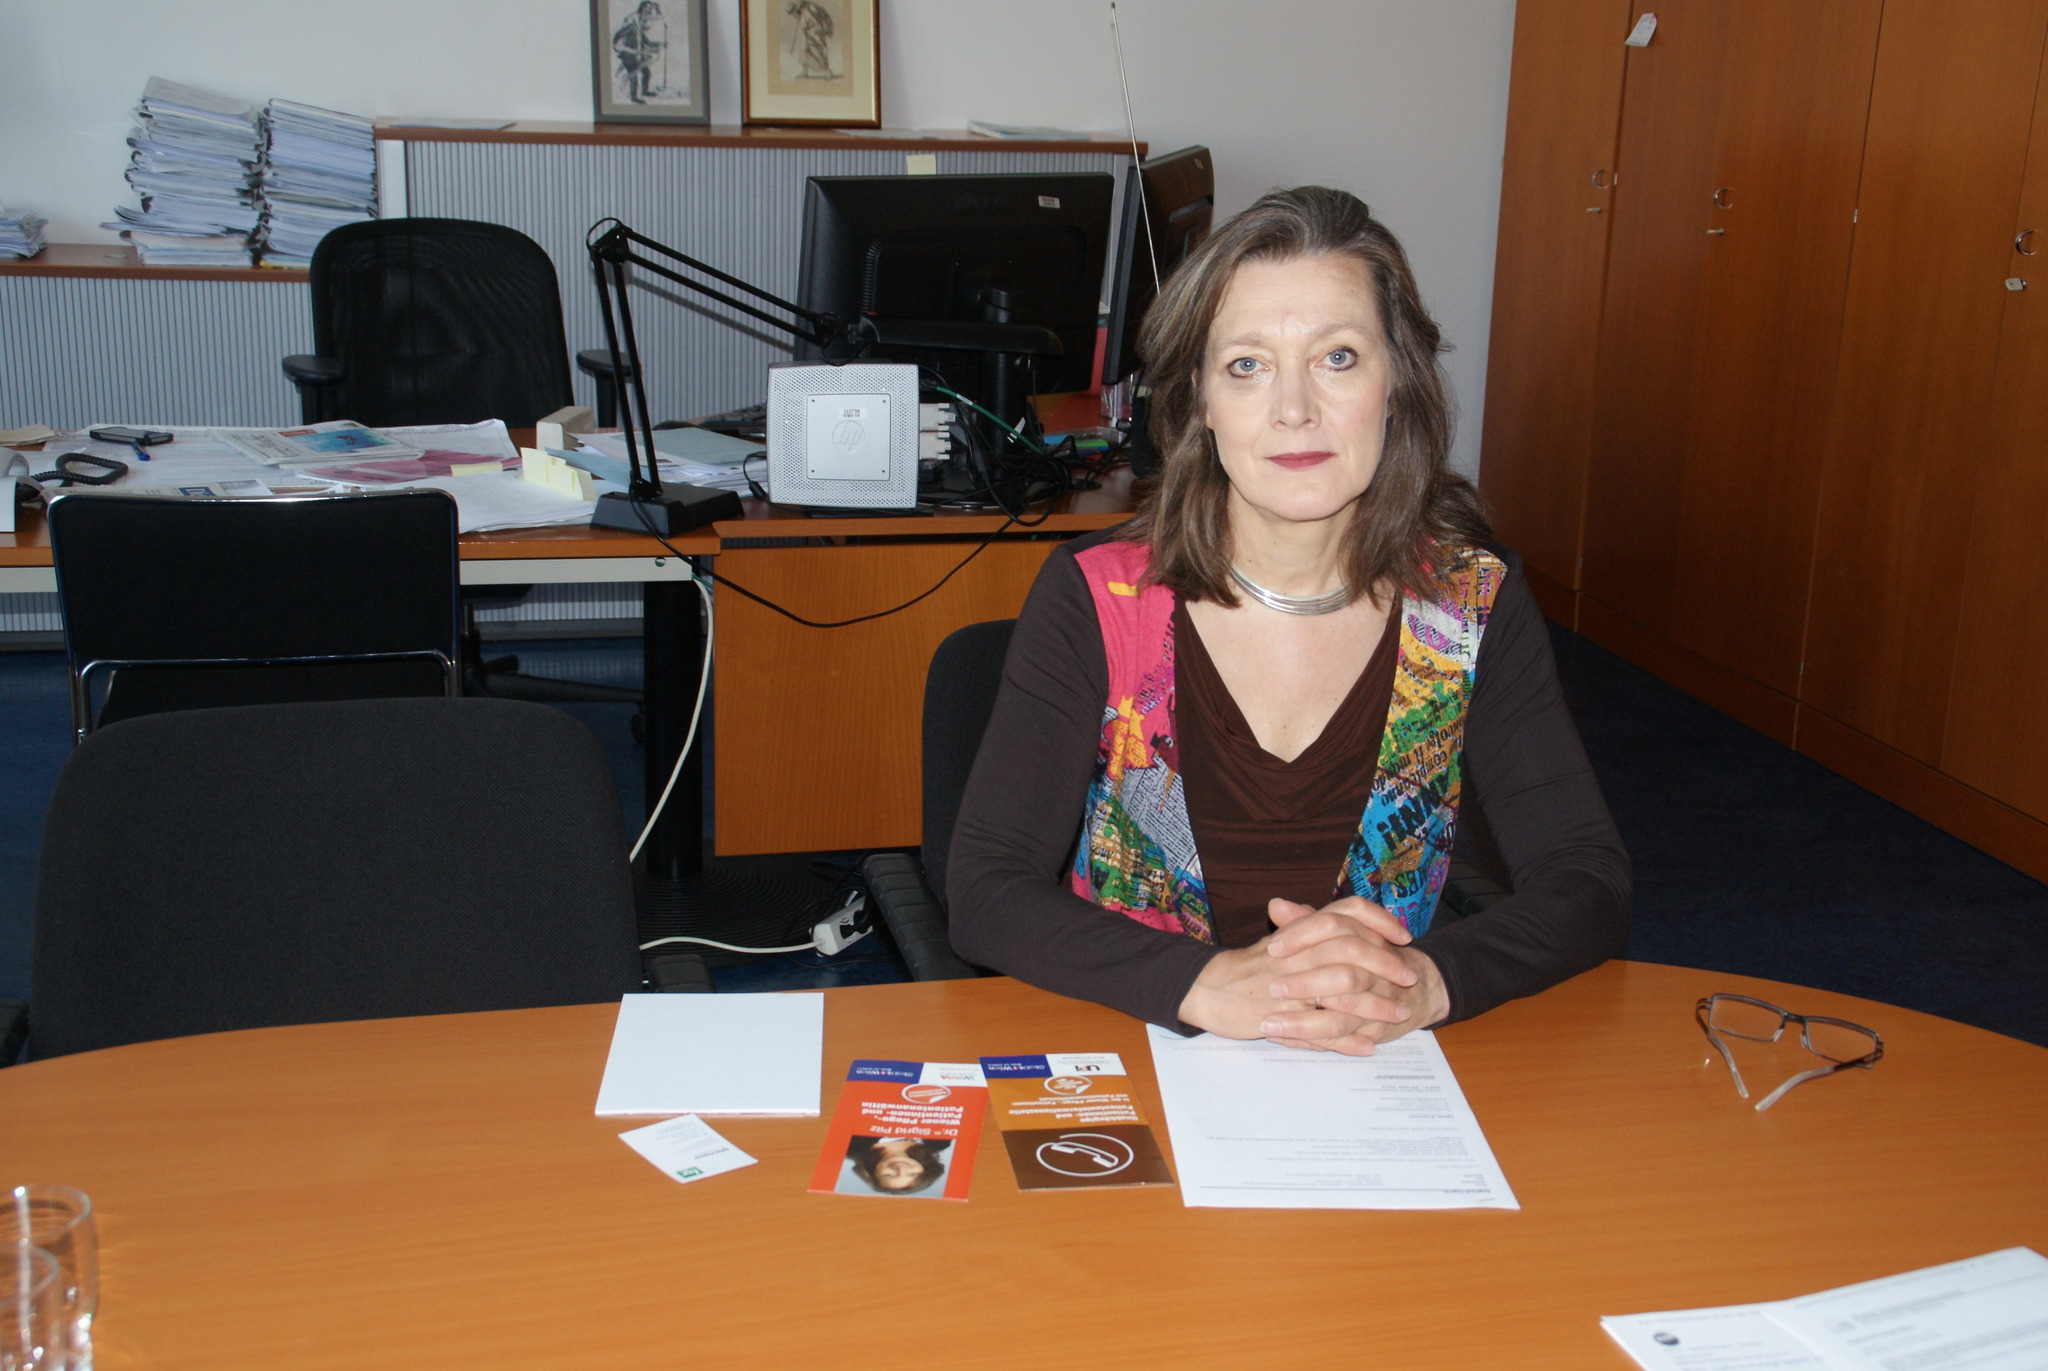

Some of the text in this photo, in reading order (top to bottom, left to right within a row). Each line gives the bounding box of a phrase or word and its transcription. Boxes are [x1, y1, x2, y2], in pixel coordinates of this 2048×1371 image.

[861, 1101, 964, 1113] Patientenanwältin
[886, 1110, 962, 1119] Patientinnen-
[920, 1118, 961, 1126] Wiener
[870, 1125, 892, 1134] Pilz
[895, 1125, 931, 1136] Sigrid
